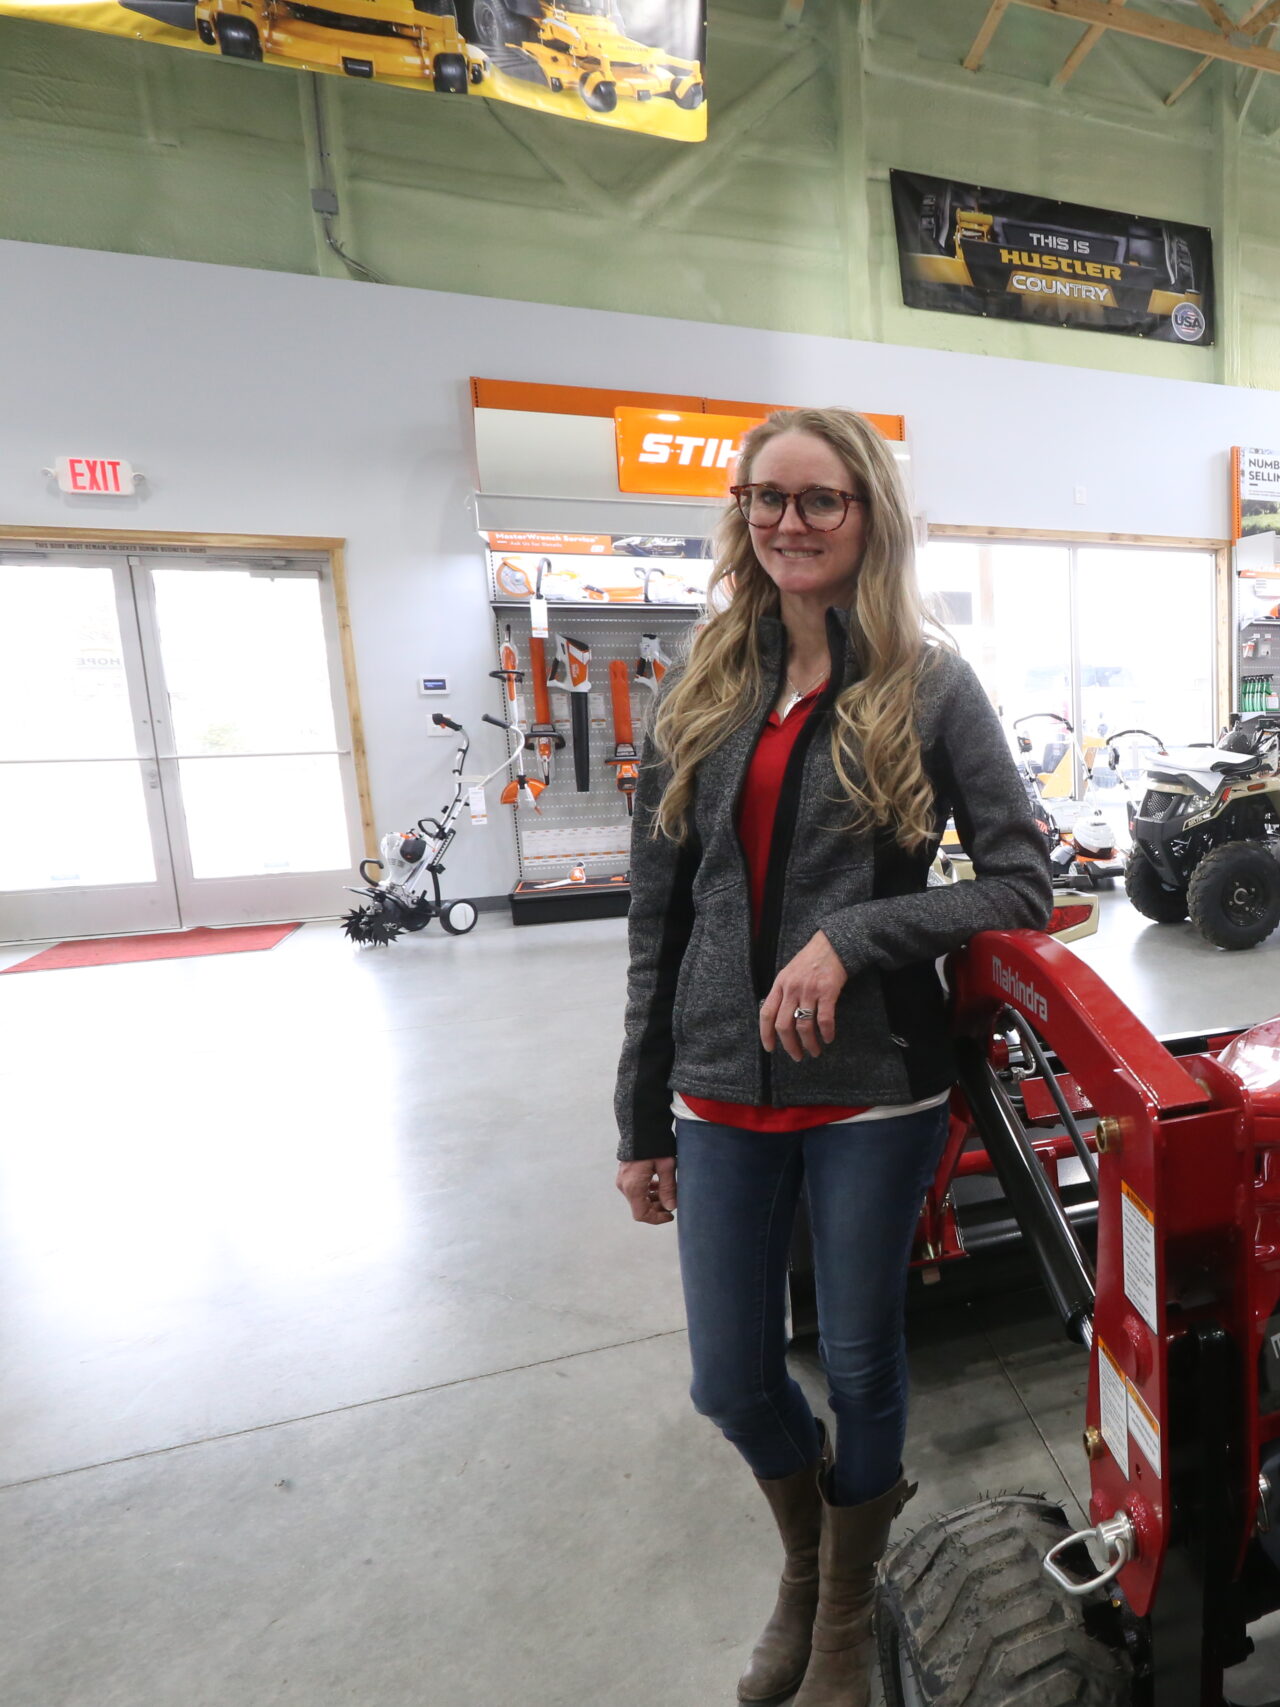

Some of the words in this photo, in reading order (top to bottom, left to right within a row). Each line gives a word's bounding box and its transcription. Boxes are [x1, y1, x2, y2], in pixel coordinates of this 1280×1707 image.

[1029, 233, 1069, 251] THIS
[1073, 239, 1090, 254] IS
[1000, 249, 1122, 281] HUSTLER
[1012, 275, 1109, 302] COUNTRY
[1174, 314, 1203, 330] USA
[638, 433, 742, 469] STIH
[68, 458, 121, 493] EXIT
[992, 955, 1049, 1022] Mahindra
